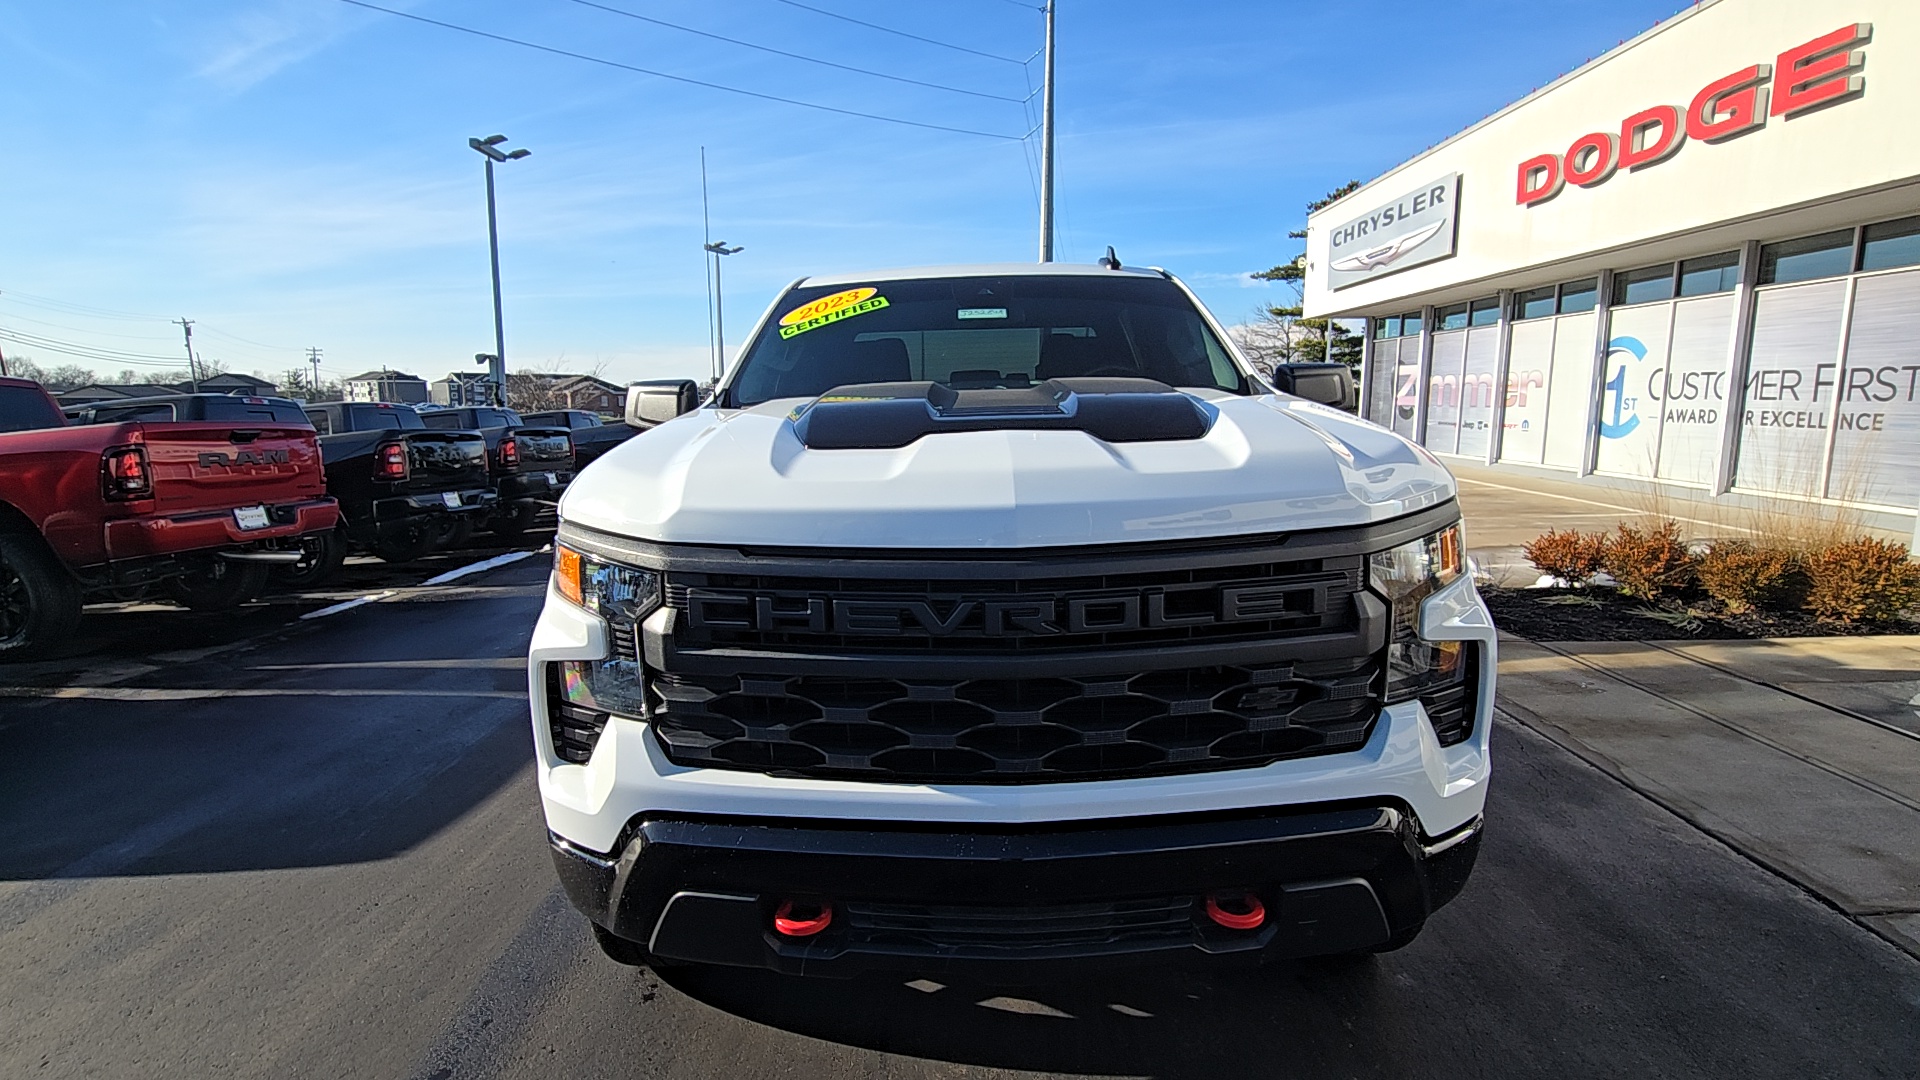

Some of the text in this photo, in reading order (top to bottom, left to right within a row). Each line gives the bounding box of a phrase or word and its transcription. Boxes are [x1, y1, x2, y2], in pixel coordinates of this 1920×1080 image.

[1517, 23, 1868, 206] DODGE
[1333, 185, 1445, 248] CHRYSLER
[783, 299, 882, 336] CERTIFIED
[800, 290, 860, 320] 2023
[1396, 364, 1544, 408] Zmmer
[1666, 409, 1718, 424] AWARD
[1760, 411, 1885, 432] EXCELLNCE
[198, 450, 289, 467] RAM
[686, 572, 1350, 636] CHEVROLET
